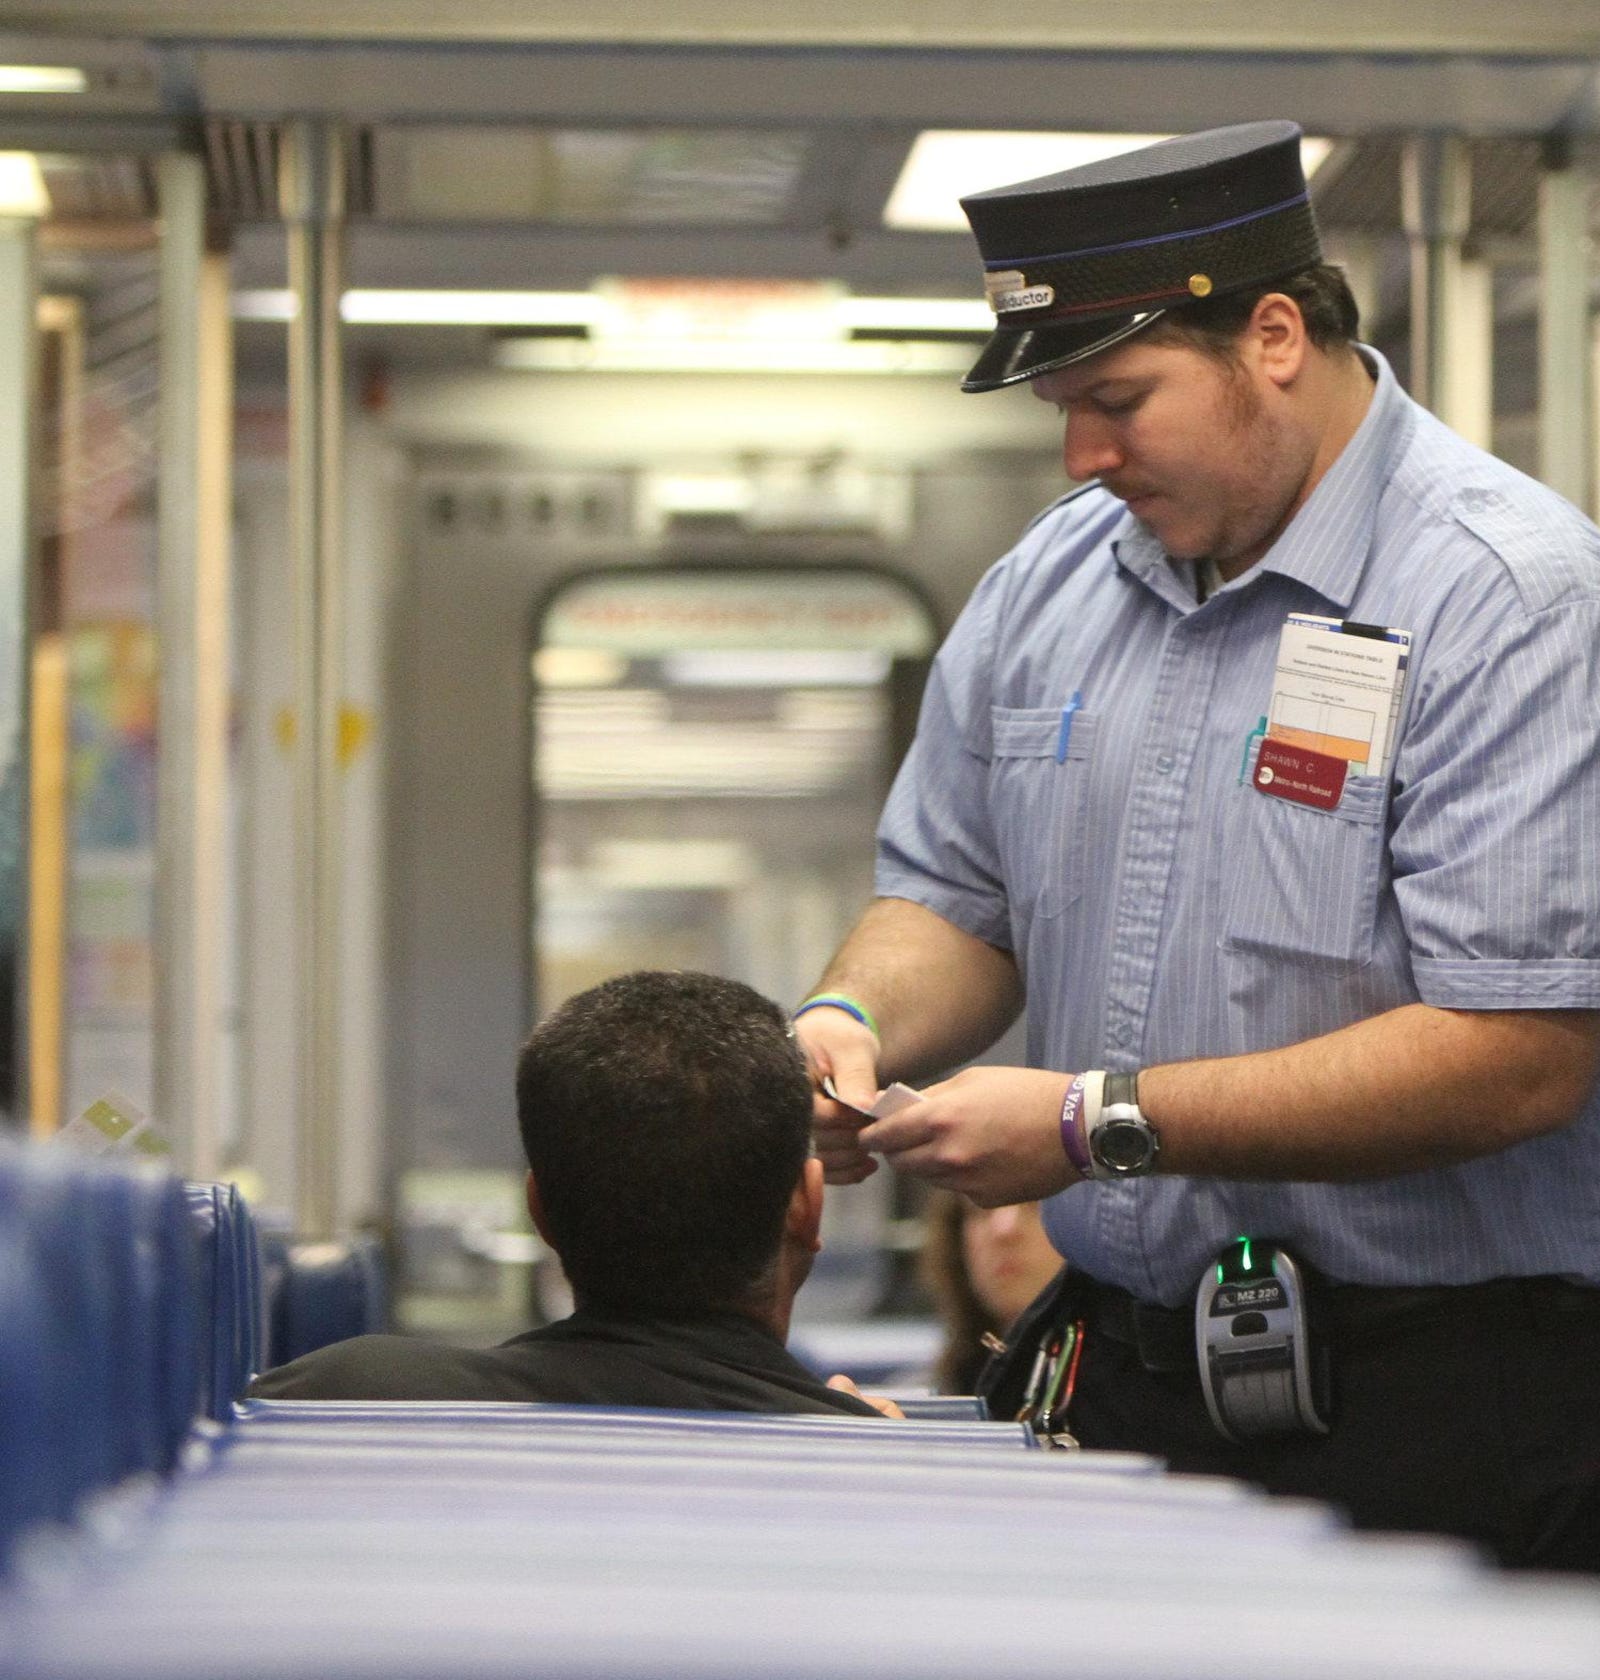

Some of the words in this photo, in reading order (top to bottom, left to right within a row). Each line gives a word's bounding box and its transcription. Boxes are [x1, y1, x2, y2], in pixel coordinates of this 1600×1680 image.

[1263, 751, 1300, 770] SHAWN
[1062, 1092, 1080, 1121] EVA
[1237, 1290, 1256, 1302] MZ
[1258, 1287, 1279, 1299] 220
